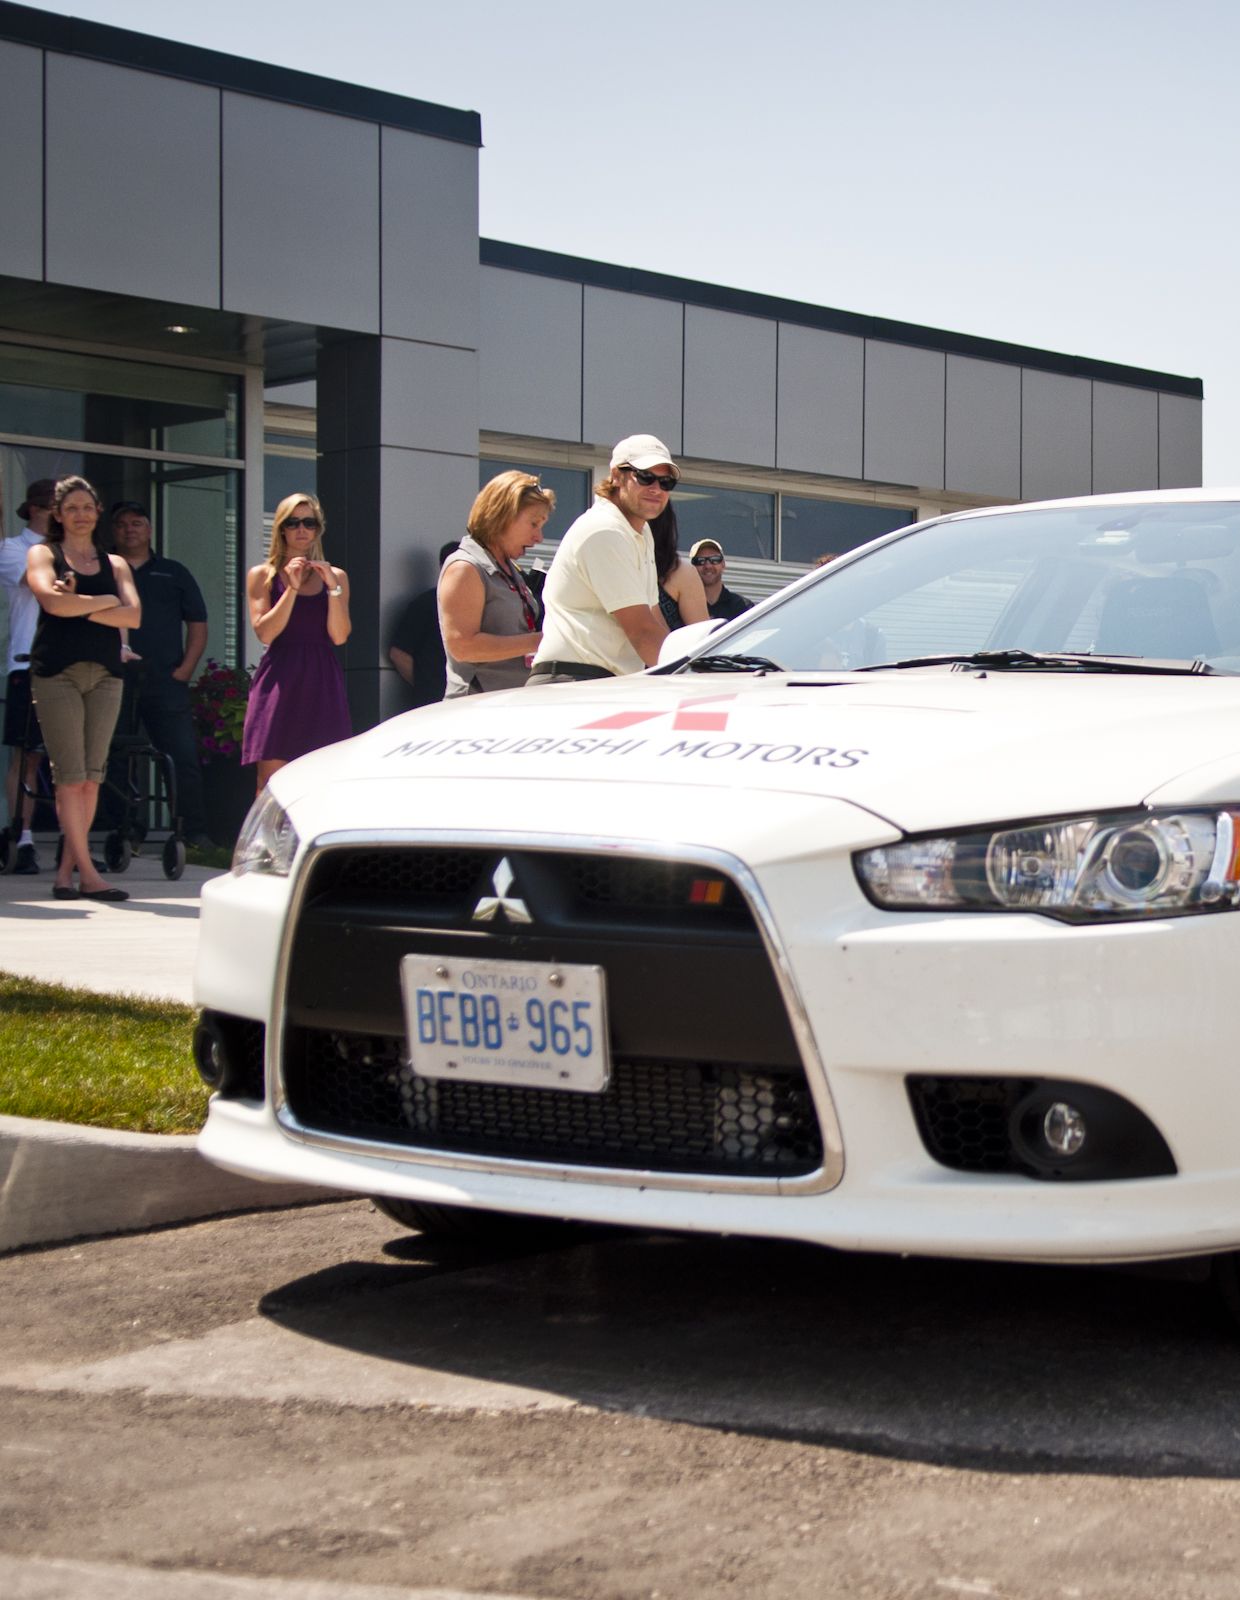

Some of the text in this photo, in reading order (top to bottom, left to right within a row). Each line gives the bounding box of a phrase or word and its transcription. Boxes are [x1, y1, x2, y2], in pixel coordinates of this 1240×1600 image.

[381, 737, 871, 769] MITSUBISHI MOTORS
[461, 970, 538, 993] ONTARIO
[416, 988, 593, 1058] BEBB 965
